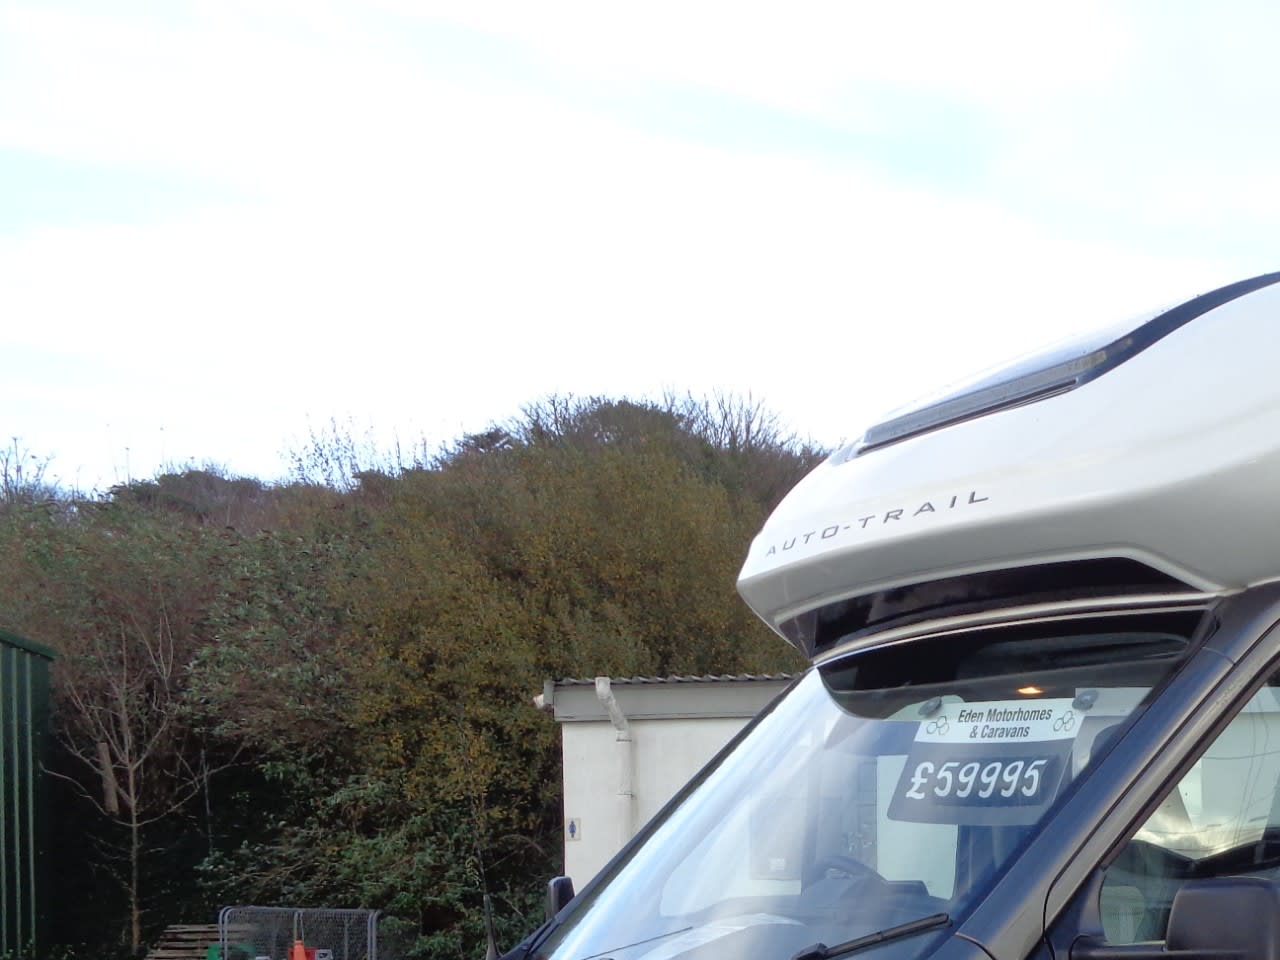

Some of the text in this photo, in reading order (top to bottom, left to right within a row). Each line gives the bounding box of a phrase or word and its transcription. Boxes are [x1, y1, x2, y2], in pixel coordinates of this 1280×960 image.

[765, 491, 989, 557] AUTO-TRAIL
[957, 707, 1053, 723] Eden Motorhomes
[969, 724, 1031, 739] & Caravans
[905, 759, 1048, 800] £59995
